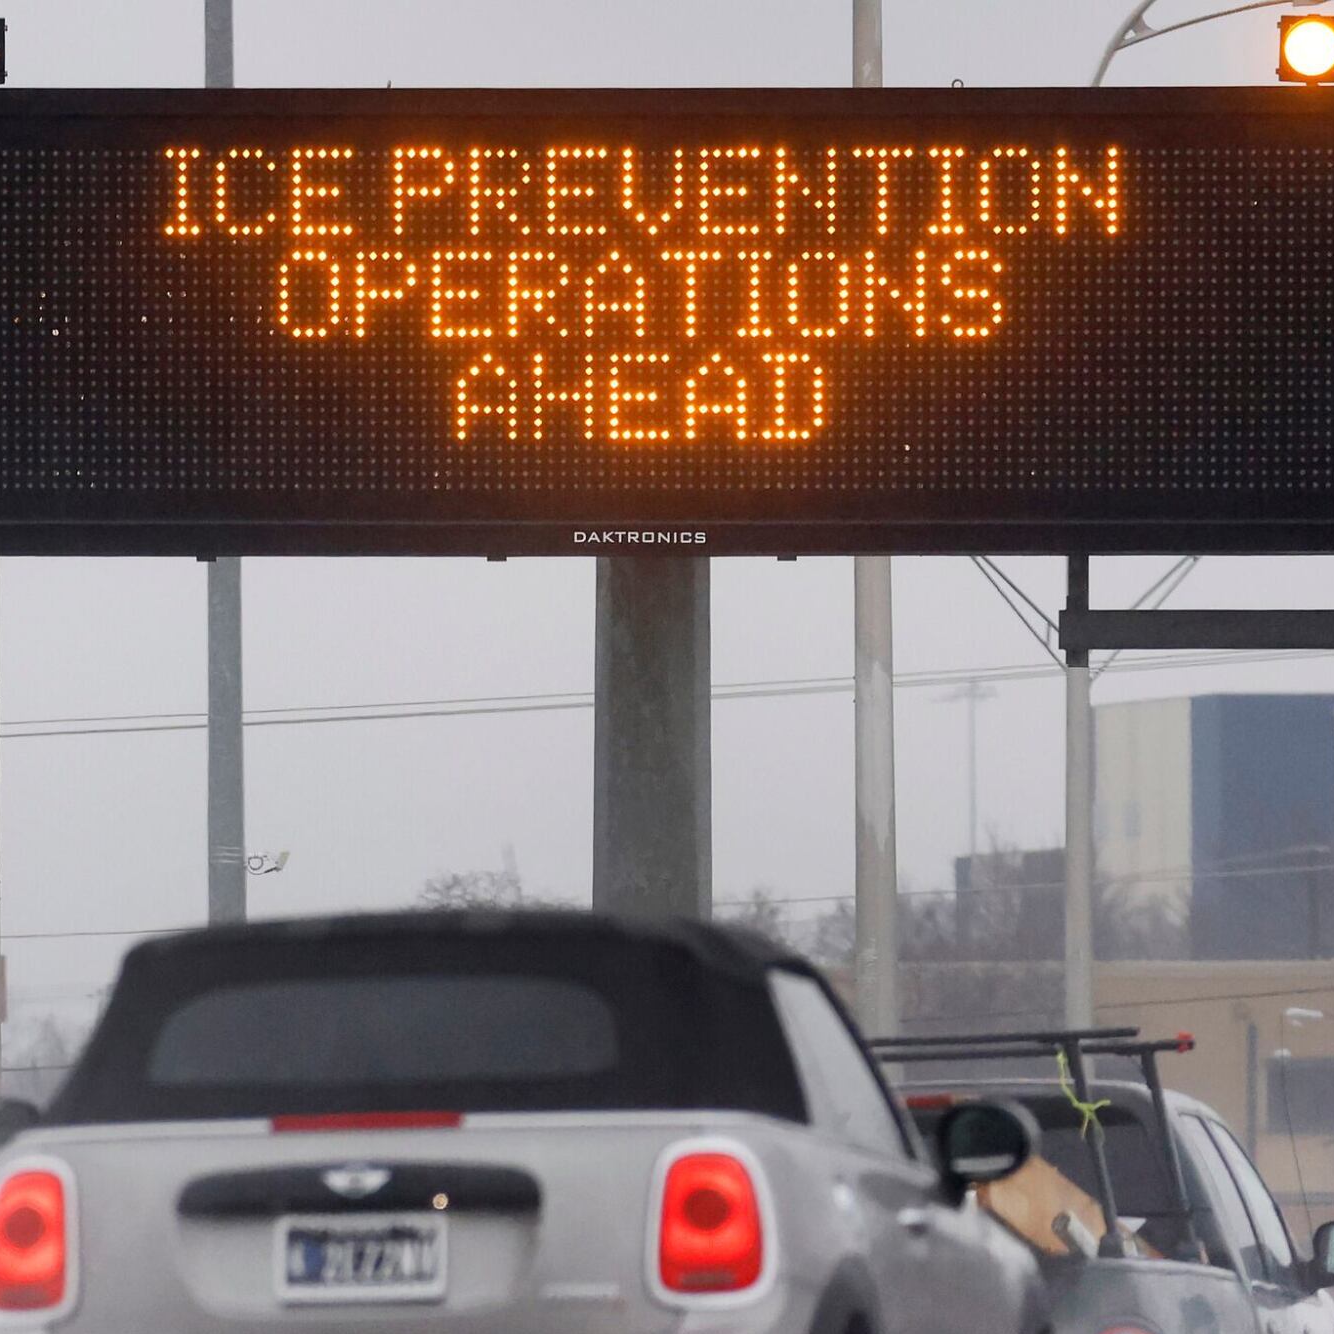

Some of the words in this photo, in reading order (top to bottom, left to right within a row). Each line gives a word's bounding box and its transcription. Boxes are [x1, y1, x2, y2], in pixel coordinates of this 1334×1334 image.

[164, 146, 353, 237] ICE
[393, 145, 1123, 236] PREVENTION
[278, 250, 1004, 339] OPERATIONS
[455, 352, 826, 442] AHEAD
[573, 531, 707, 544] DAKTRONICS
